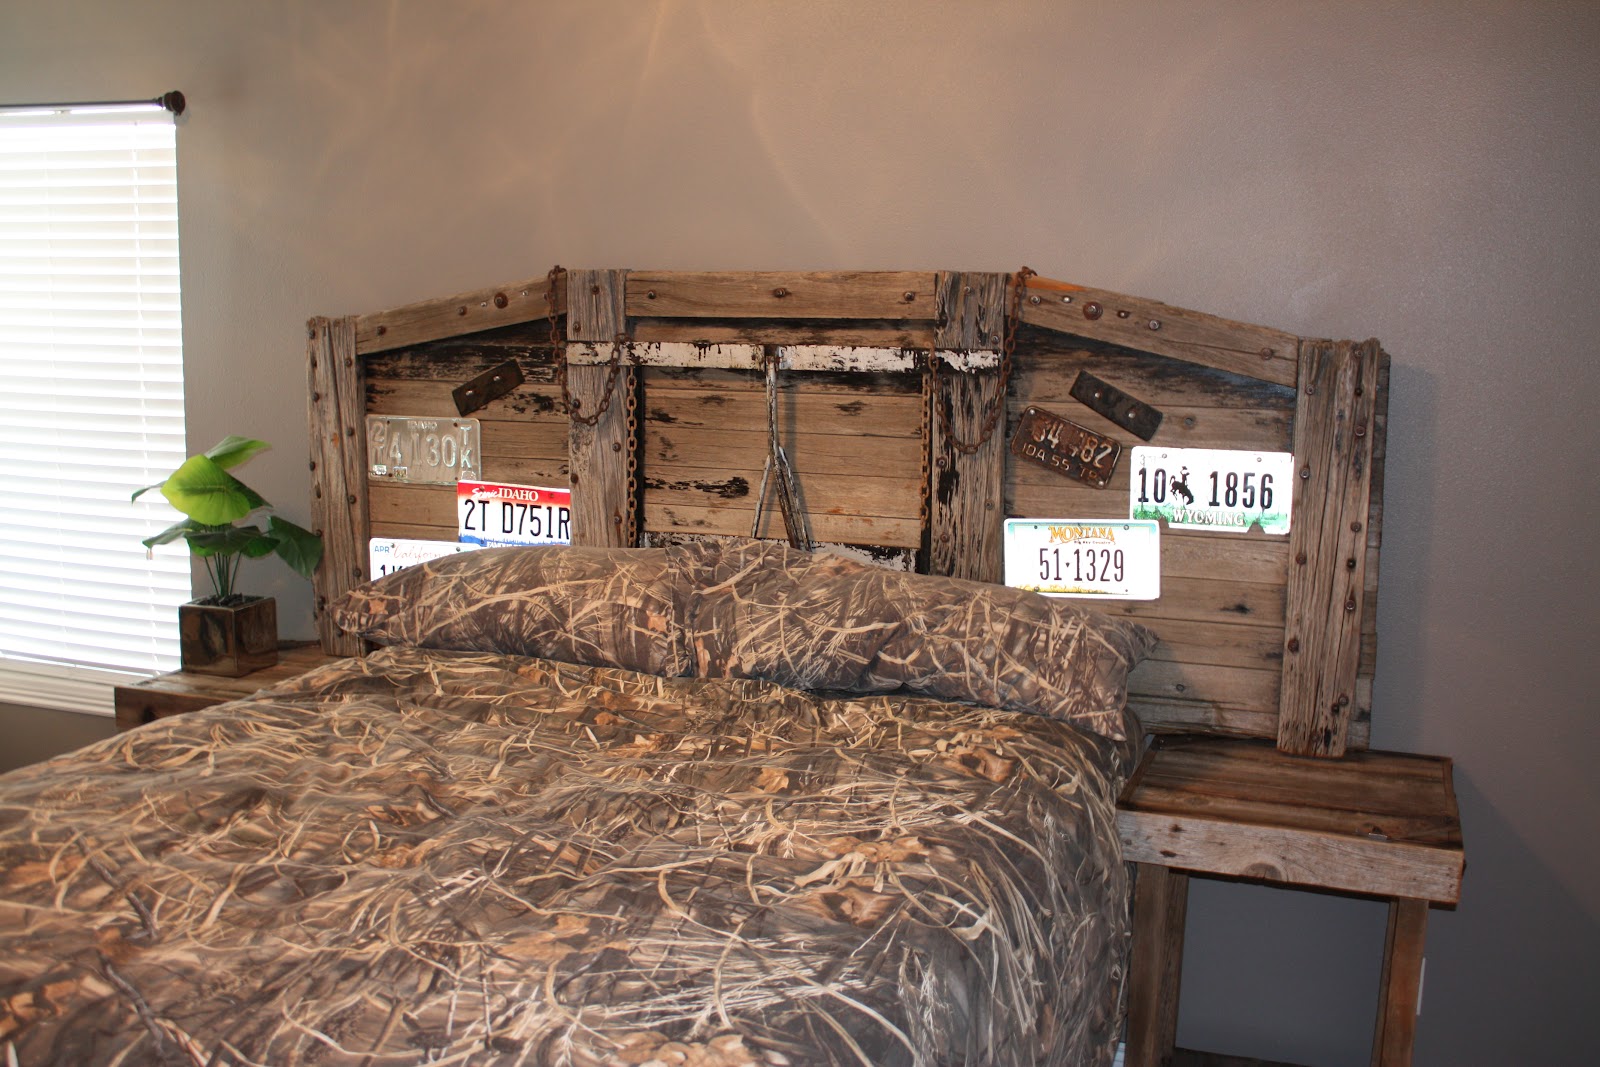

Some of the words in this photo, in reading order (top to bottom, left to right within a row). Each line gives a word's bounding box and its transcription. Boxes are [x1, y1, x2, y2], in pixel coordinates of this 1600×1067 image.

[498, 487, 539, 501] IDAHO
[1138, 467, 1167, 503] 10
[1208, 471, 1274, 509] 1856
[464, 499, 490, 532] 2T
[502, 501, 570, 540] D751R
[1173, 508, 1245, 525] WYOMING
[1048, 525, 1115, 544] MONTANA
[374, 545, 390, 553] APR
